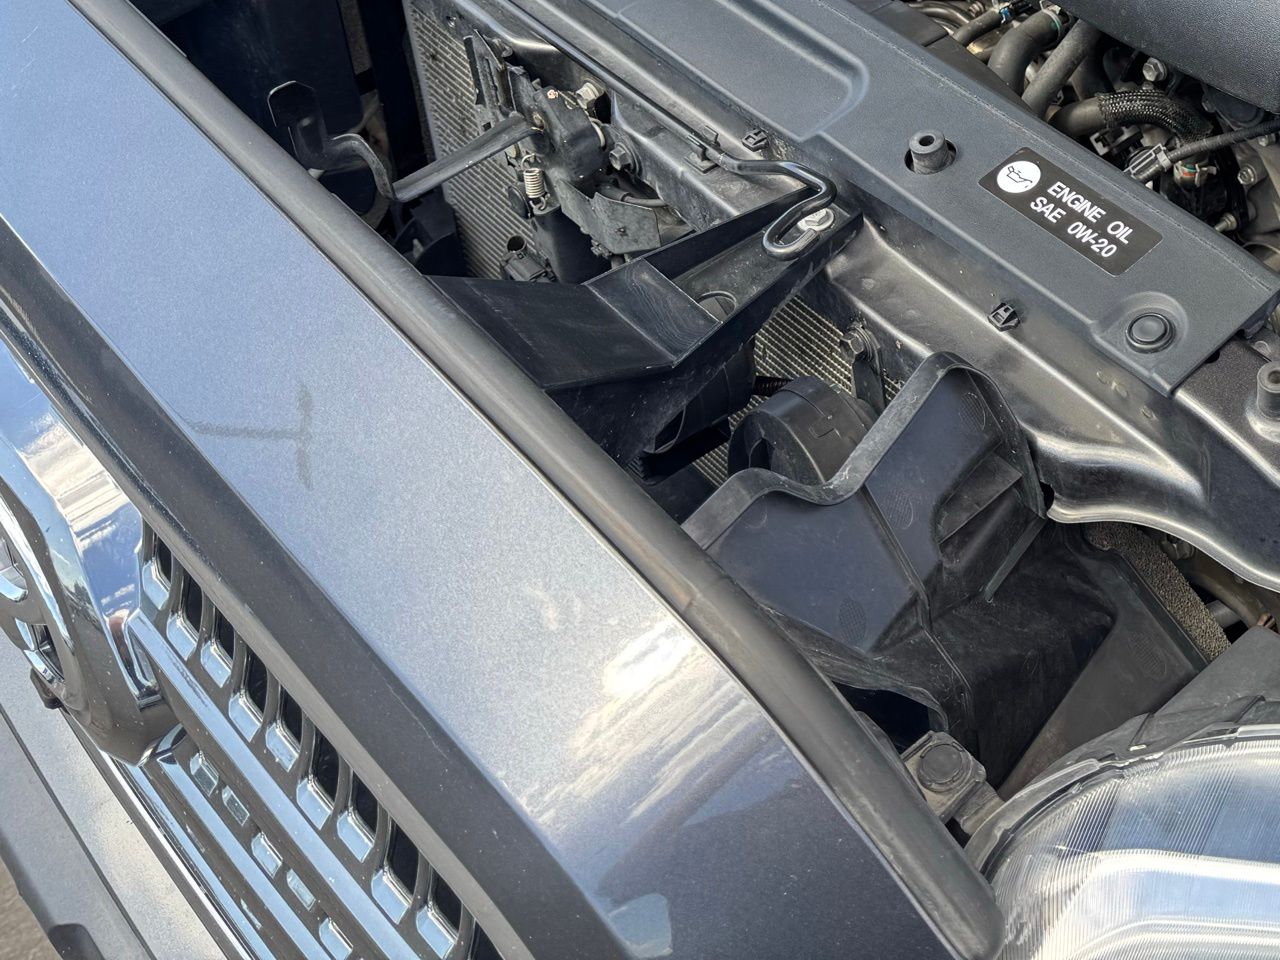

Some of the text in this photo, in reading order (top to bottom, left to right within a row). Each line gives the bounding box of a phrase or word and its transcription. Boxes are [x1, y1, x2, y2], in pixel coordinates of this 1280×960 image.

[1030, 196, 1117, 258] SAE 0W-20
[1046, 181, 1133, 244] ENGINE OIL
